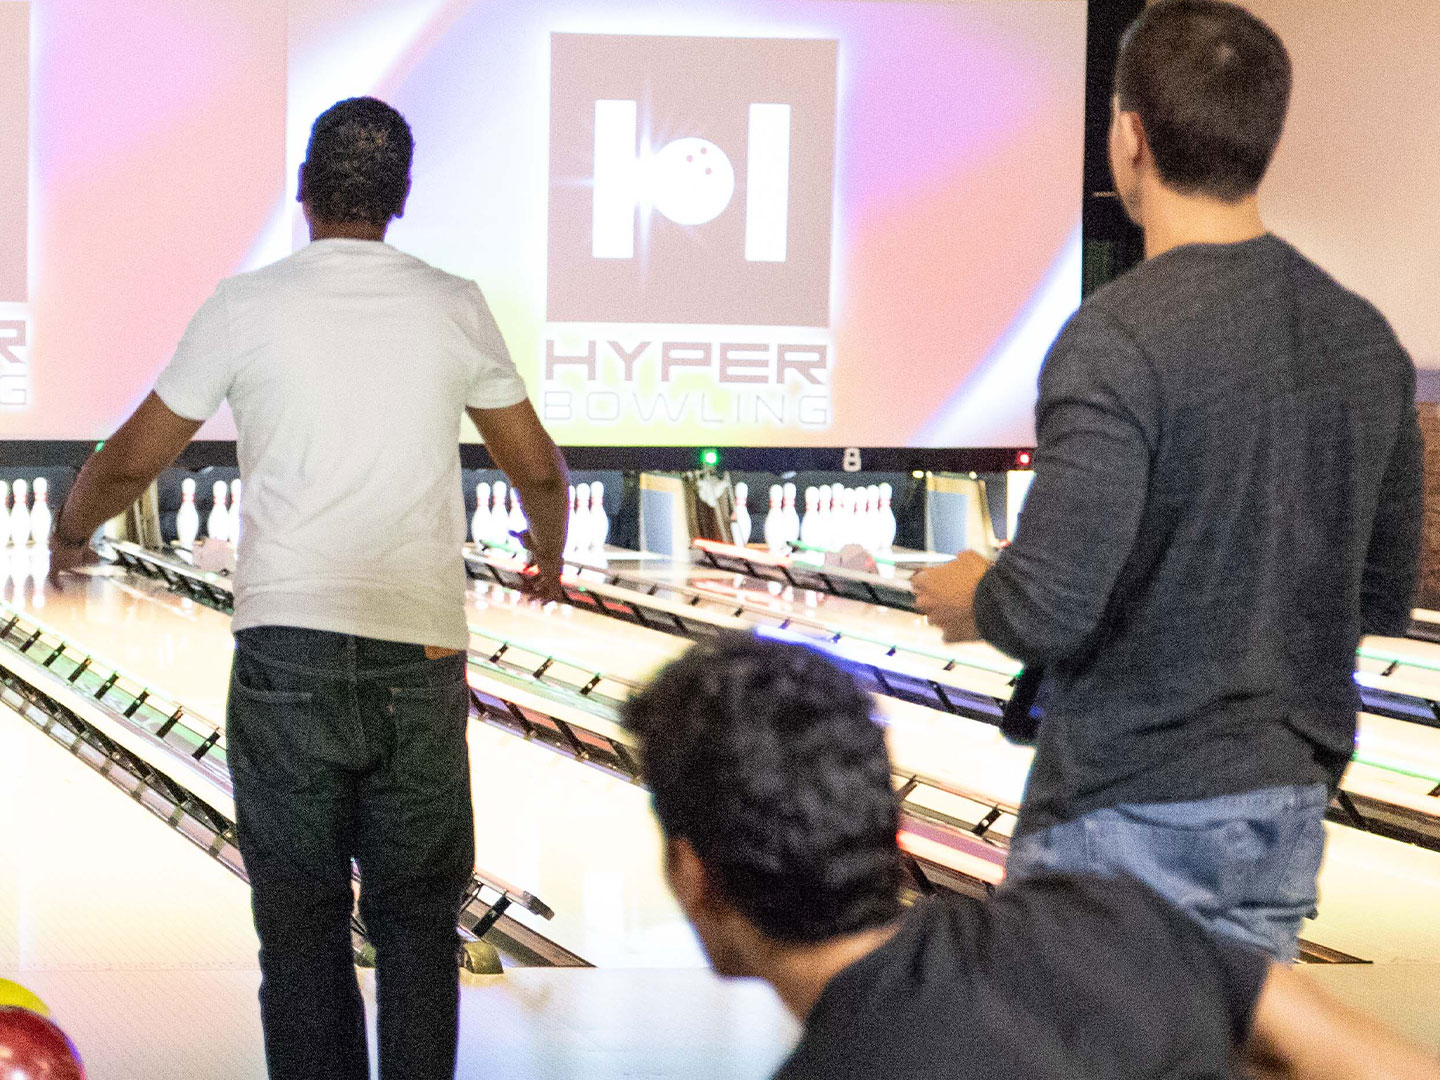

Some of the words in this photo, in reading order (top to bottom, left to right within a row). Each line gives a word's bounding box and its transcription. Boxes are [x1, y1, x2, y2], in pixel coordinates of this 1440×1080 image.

[545, 340, 828, 385] HYPER
[544, 391, 828, 424] BOWLING
[842, 447, 862, 472] 8
